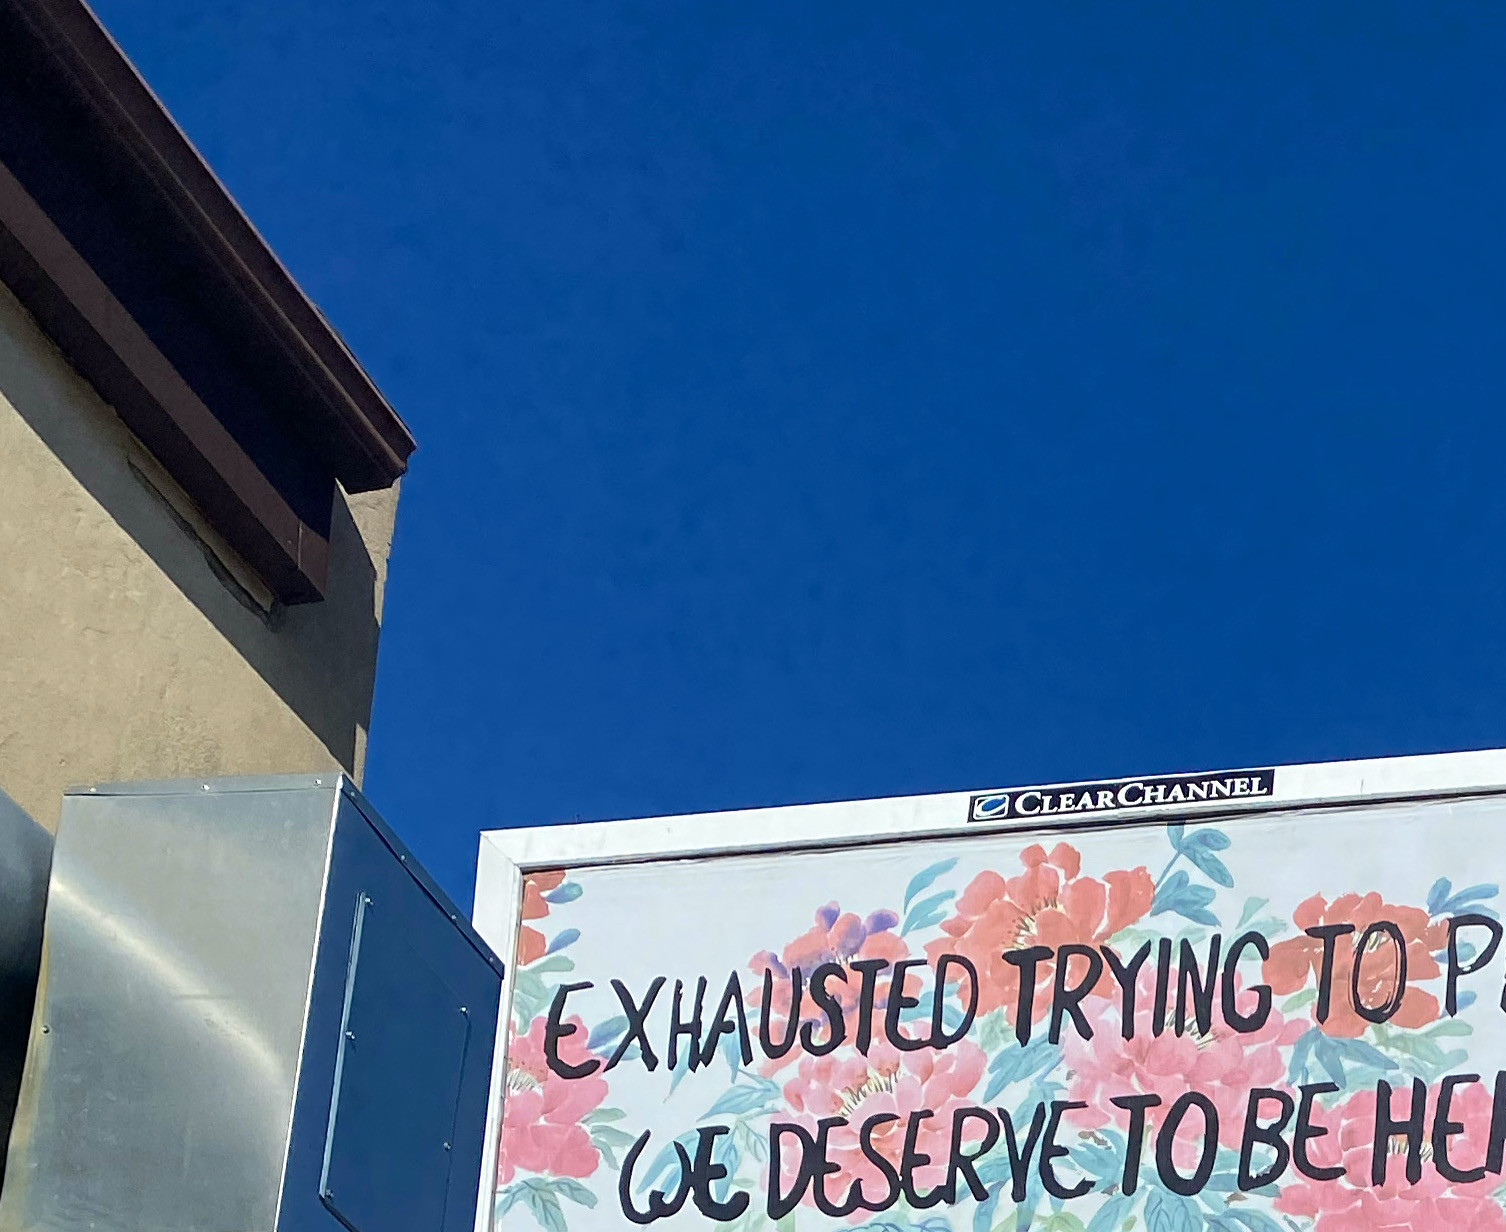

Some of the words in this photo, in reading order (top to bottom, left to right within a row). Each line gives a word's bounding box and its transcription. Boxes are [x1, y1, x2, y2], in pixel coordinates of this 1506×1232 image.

[543, 953, 979, 1080] EXHAUSTED
[1001, 931, 1272, 1048] TRYING
[1304, 920, 1408, 1026] TO
[618, 1124, 750, 1225] WE
[767, 1100, 1096, 1221] DESERVE
[1109, 1091, 1220, 1197] TO
[1237, 1081, 1347, 1192] BE
